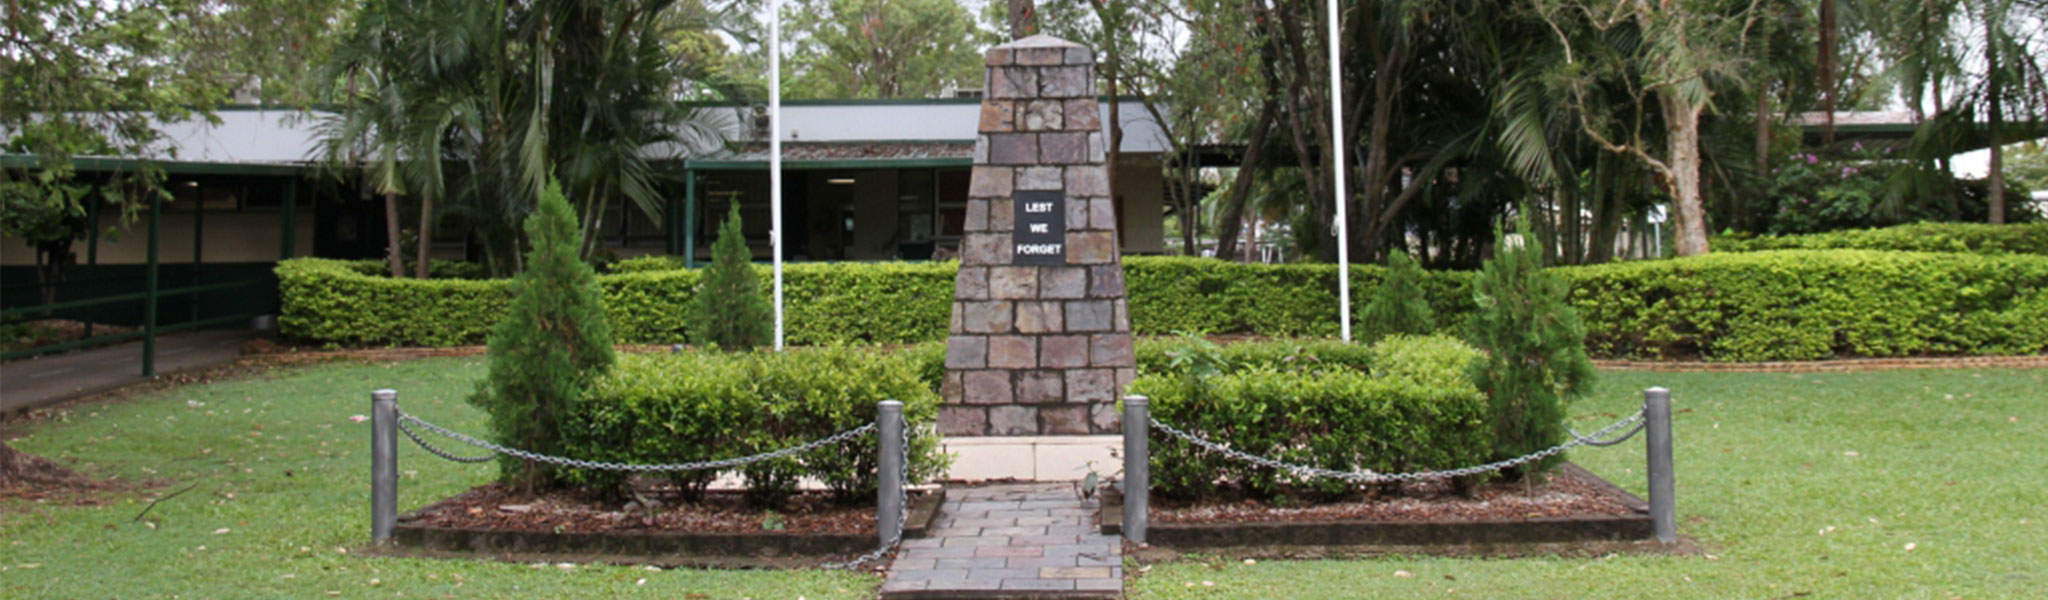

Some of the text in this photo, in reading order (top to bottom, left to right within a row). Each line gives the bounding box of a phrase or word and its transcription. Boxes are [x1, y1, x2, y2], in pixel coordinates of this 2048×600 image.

[1025, 202, 1053, 213] LEST
[1030, 223, 1048, 233] WE
[1017, 243, 1062, 255] FORGET
